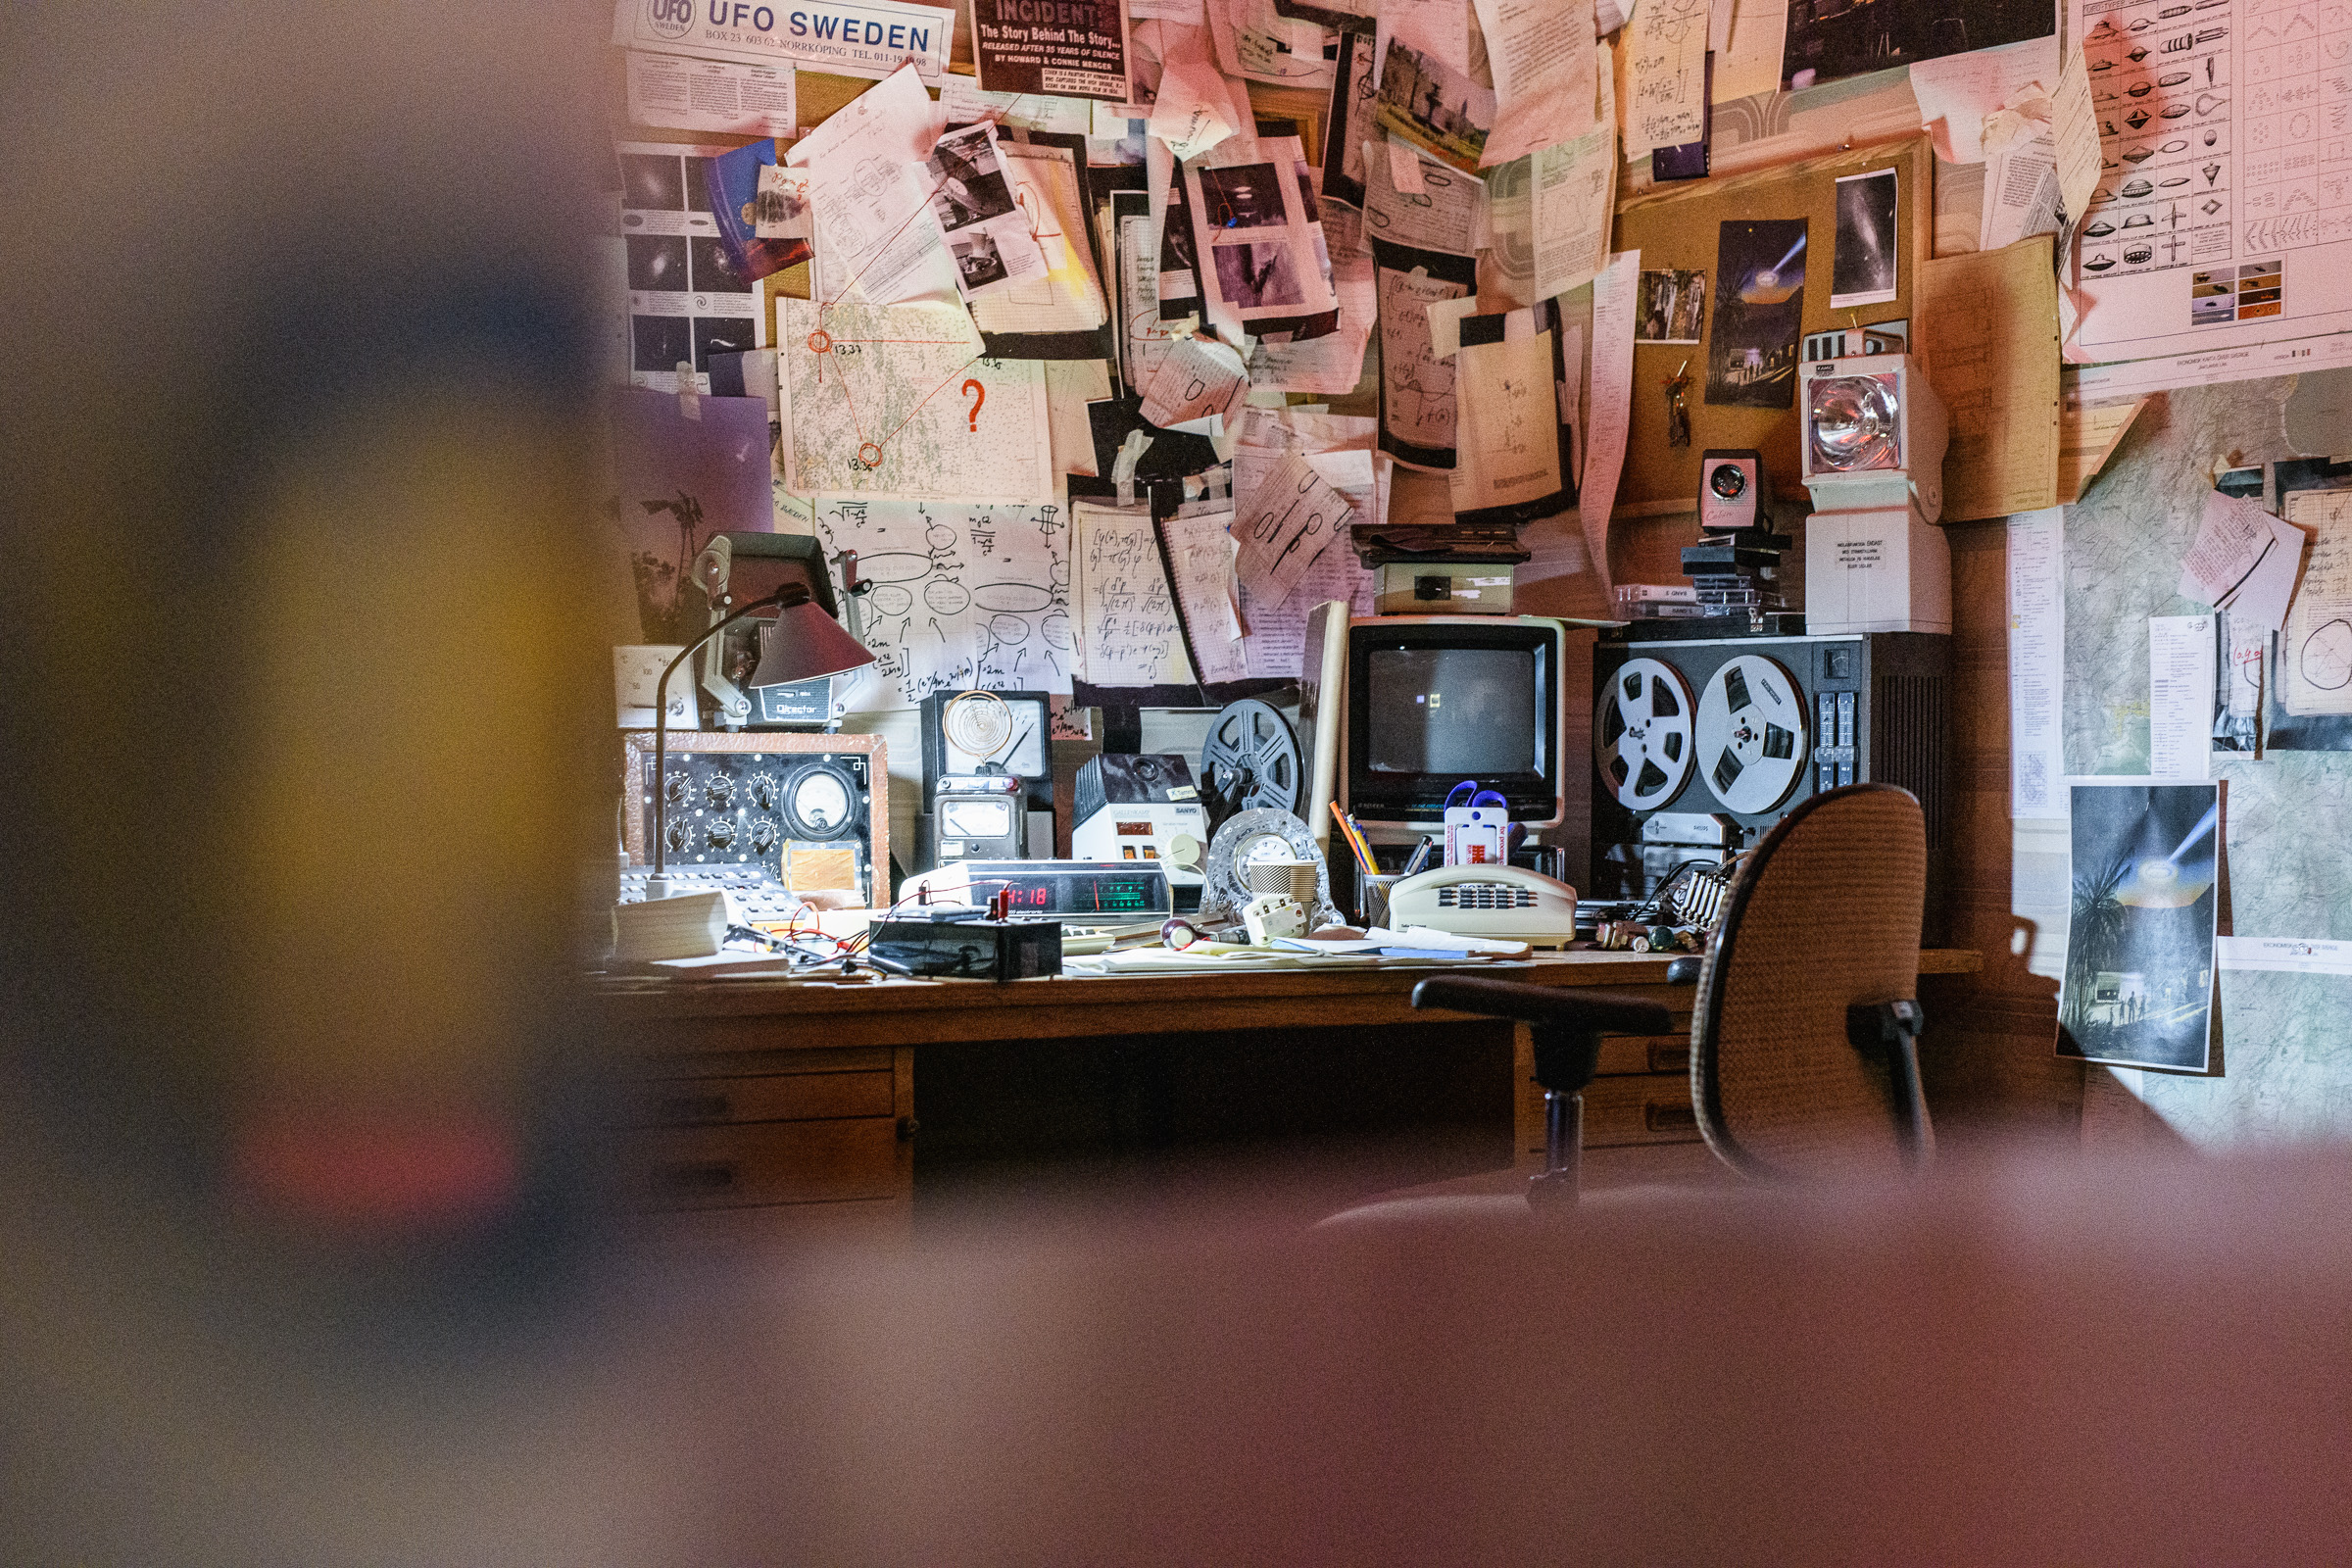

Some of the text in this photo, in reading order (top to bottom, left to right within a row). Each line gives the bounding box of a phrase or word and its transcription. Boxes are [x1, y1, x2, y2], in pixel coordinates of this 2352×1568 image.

[653, 0, 692, 24] UFO
[655, 22, 685, 32] SWEDEN
[709, 0, 929, 52] UFO SWEDEN
[981, 24, 1121, 49] The Story Behind The Story...
[706, 29, 728, 41] BOX
[730, 32, 742, 43] 23
[746, 34, 762, 46] 603
[763, 37, 775, 48] 62
[852, 49, 872, 61] TEL.
[873, 52, 904, 65] 011-19
[915, 56, 927, 67] 98
[982, 42, 1020, 51] RELEASED
[1021, 44, 1045, 53] AFTER
[1057, 46, 1079, 56] YEARS
[1081, 48, 1090, 57] OF
[1092, 50, 1120, 60] SILENCE
[1007, 55, 1041, 65] HOWARD
[1052, 58, 1080, 67] CONNIE
[1082, 60, 1112, 71] MENGER
[961, 378, 986, 432] ?
